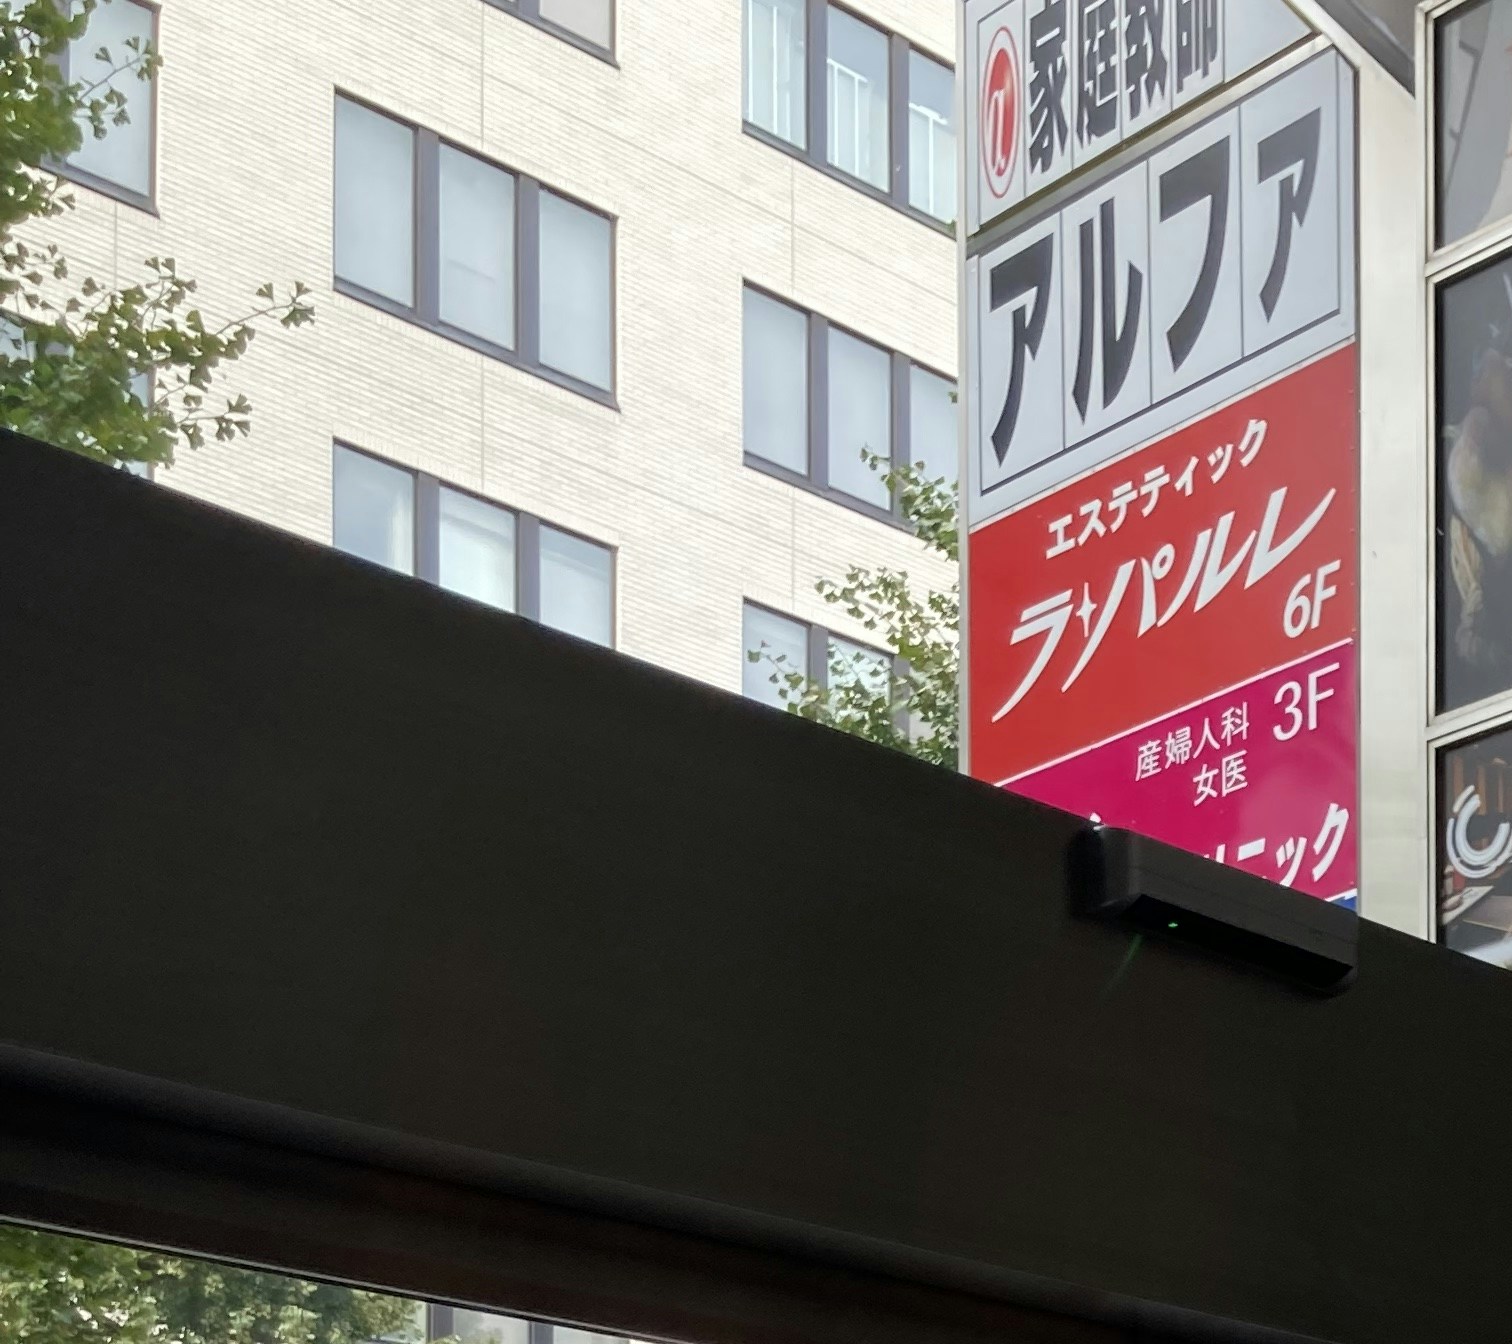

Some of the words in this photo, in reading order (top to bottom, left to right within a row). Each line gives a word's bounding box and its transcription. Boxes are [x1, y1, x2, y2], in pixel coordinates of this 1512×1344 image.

[990, 107, 1321, 467] アルファ
[1046, 418, 1268, 560] エステティック
[1282, 559, 1342, 639] 6F
[1135, 701, 1250, 782] 産婦人科
[1273, 662, 1341, 742] 3F
[1193, 750, 1249, 807] 女医
